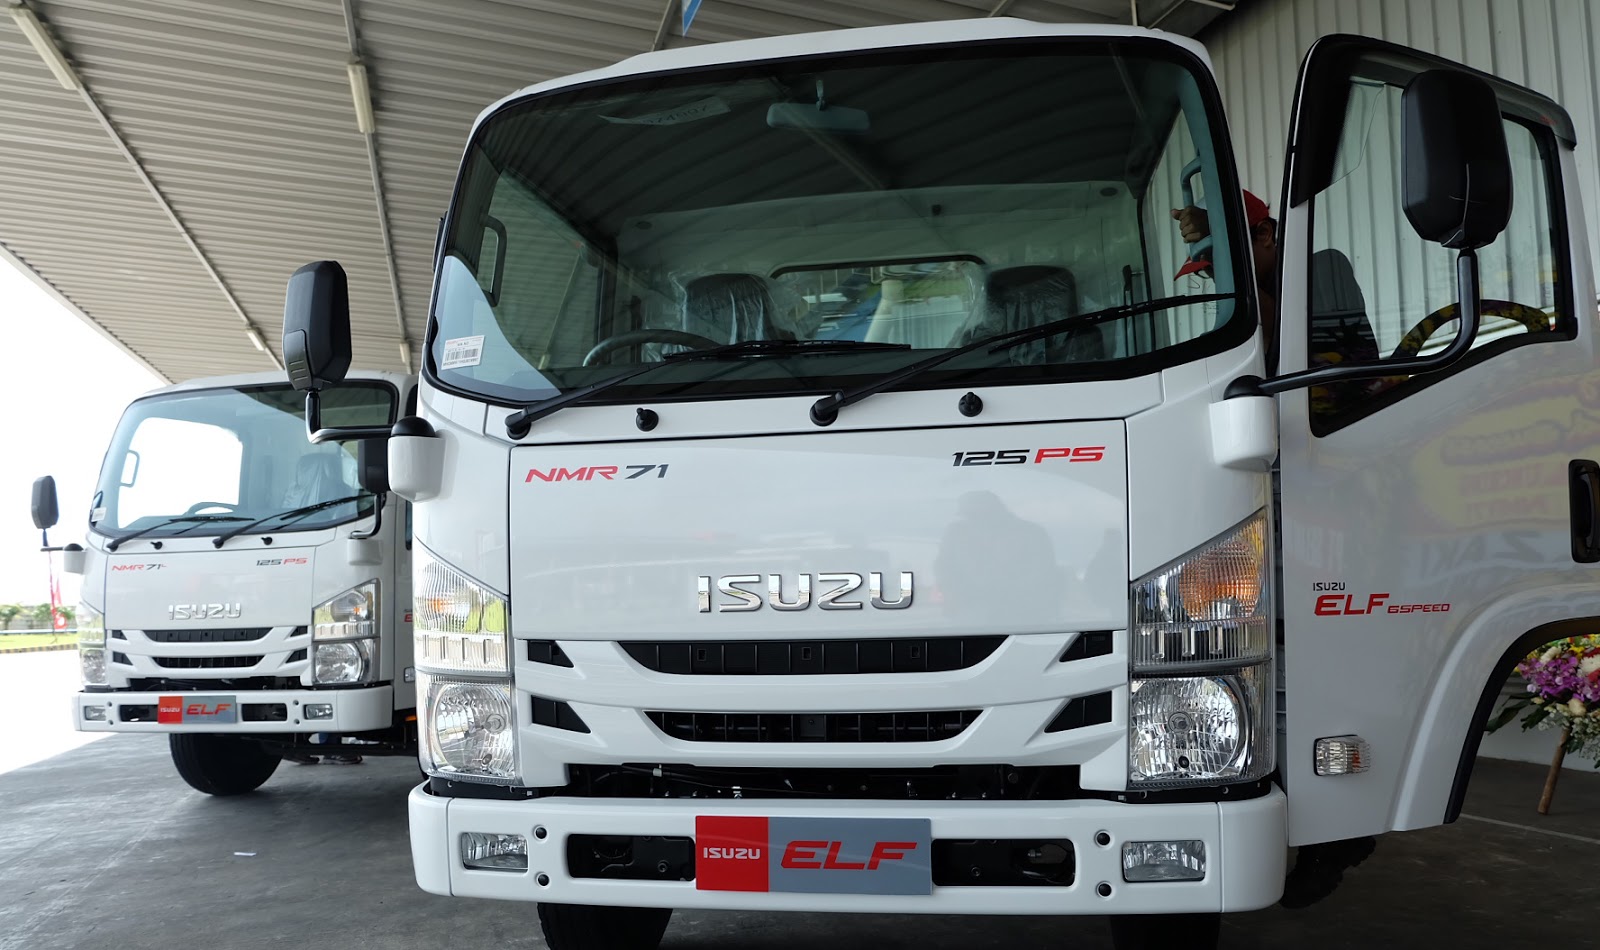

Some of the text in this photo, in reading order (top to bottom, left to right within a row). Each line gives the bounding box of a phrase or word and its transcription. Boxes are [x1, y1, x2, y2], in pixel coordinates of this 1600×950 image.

[952, 446, 1106, 467] 125 PS
[525, 464, 669, 483] NMR 71
[256, 557, 308, 566] 125 PS
[698, 571, 914, 613] ISUZU
[1313, 582, 1346, 591] ISUZU
[168, 602, 242, 620] ISUZU
[1314, 593, 1450, 616] ELF 6SPEED
[186, 703, 232, 715] ELF
[703, 840, 917, 870] ISUZU ELF
